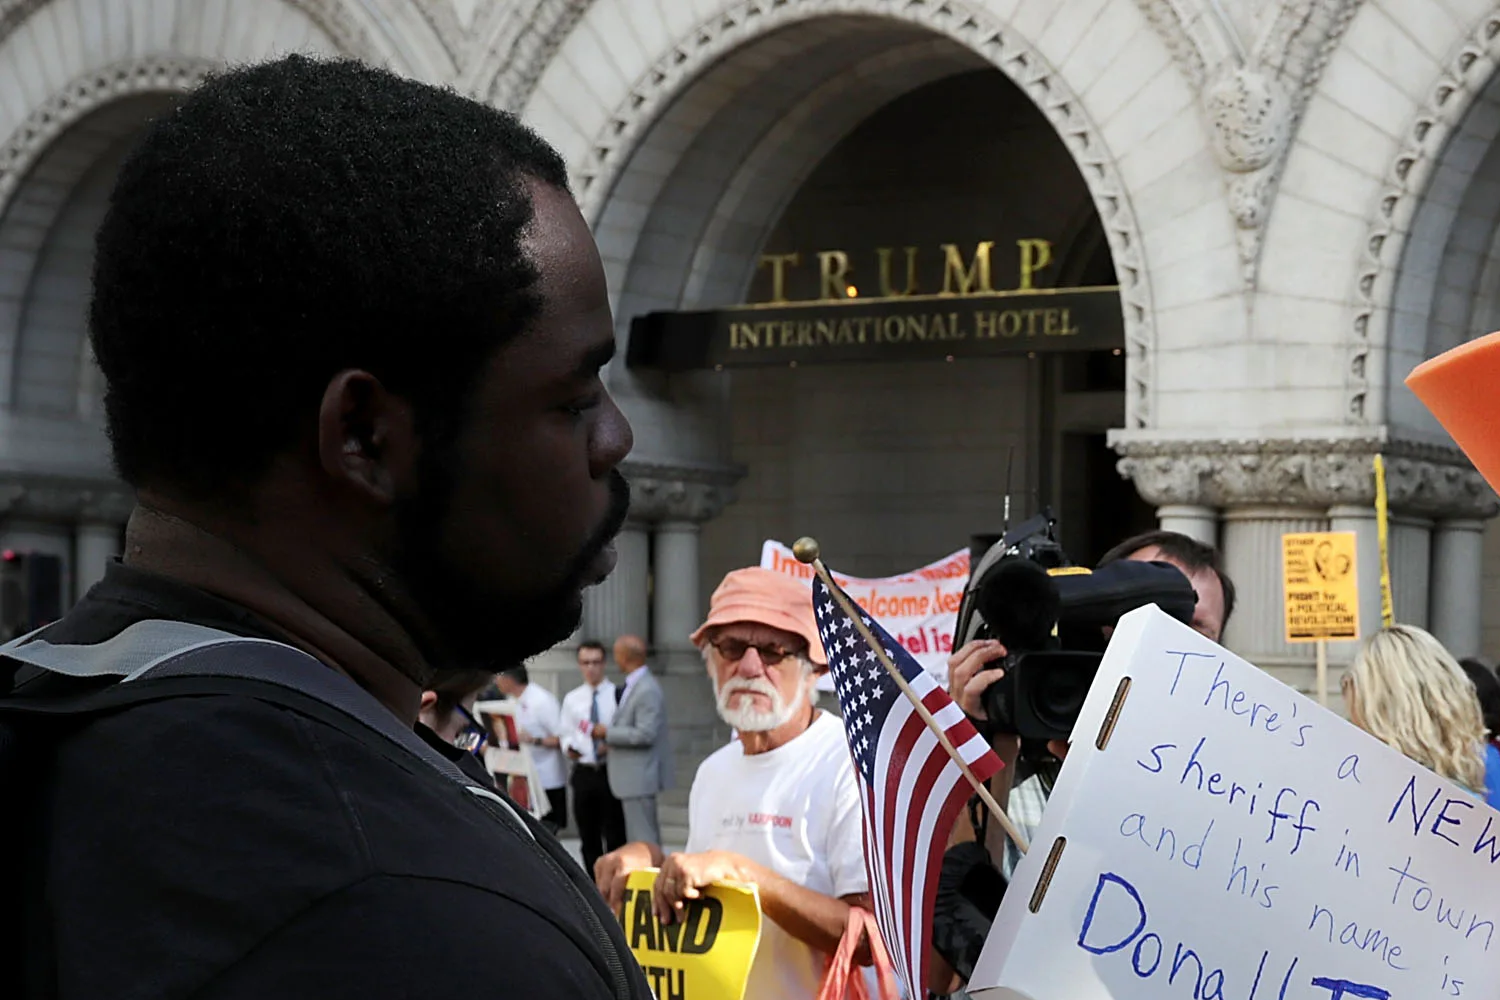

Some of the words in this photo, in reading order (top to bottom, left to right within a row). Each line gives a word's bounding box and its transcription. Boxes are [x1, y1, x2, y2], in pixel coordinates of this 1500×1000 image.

[758, 237, 1055, 302] TRUMP
[729, 315, 966, 349] INTERNATIONAL
[975, 308, 1079, 338] HOTEL
[857, 588, 929, 617] elcome
[1165, 649, 1313, 747] There's
[1337, 752, 1362, 784] a
[1136, 737, 1321, 854] sheriff
[1338, 829, 1362, 878] in
[1390, 862, 1496, 953] town
[1120, 810, 1215, 871] and
[1226, 839, 1281, 909] his
[1308, 903, 1409, 972] name
[1442, 955, 1466, 997] is
